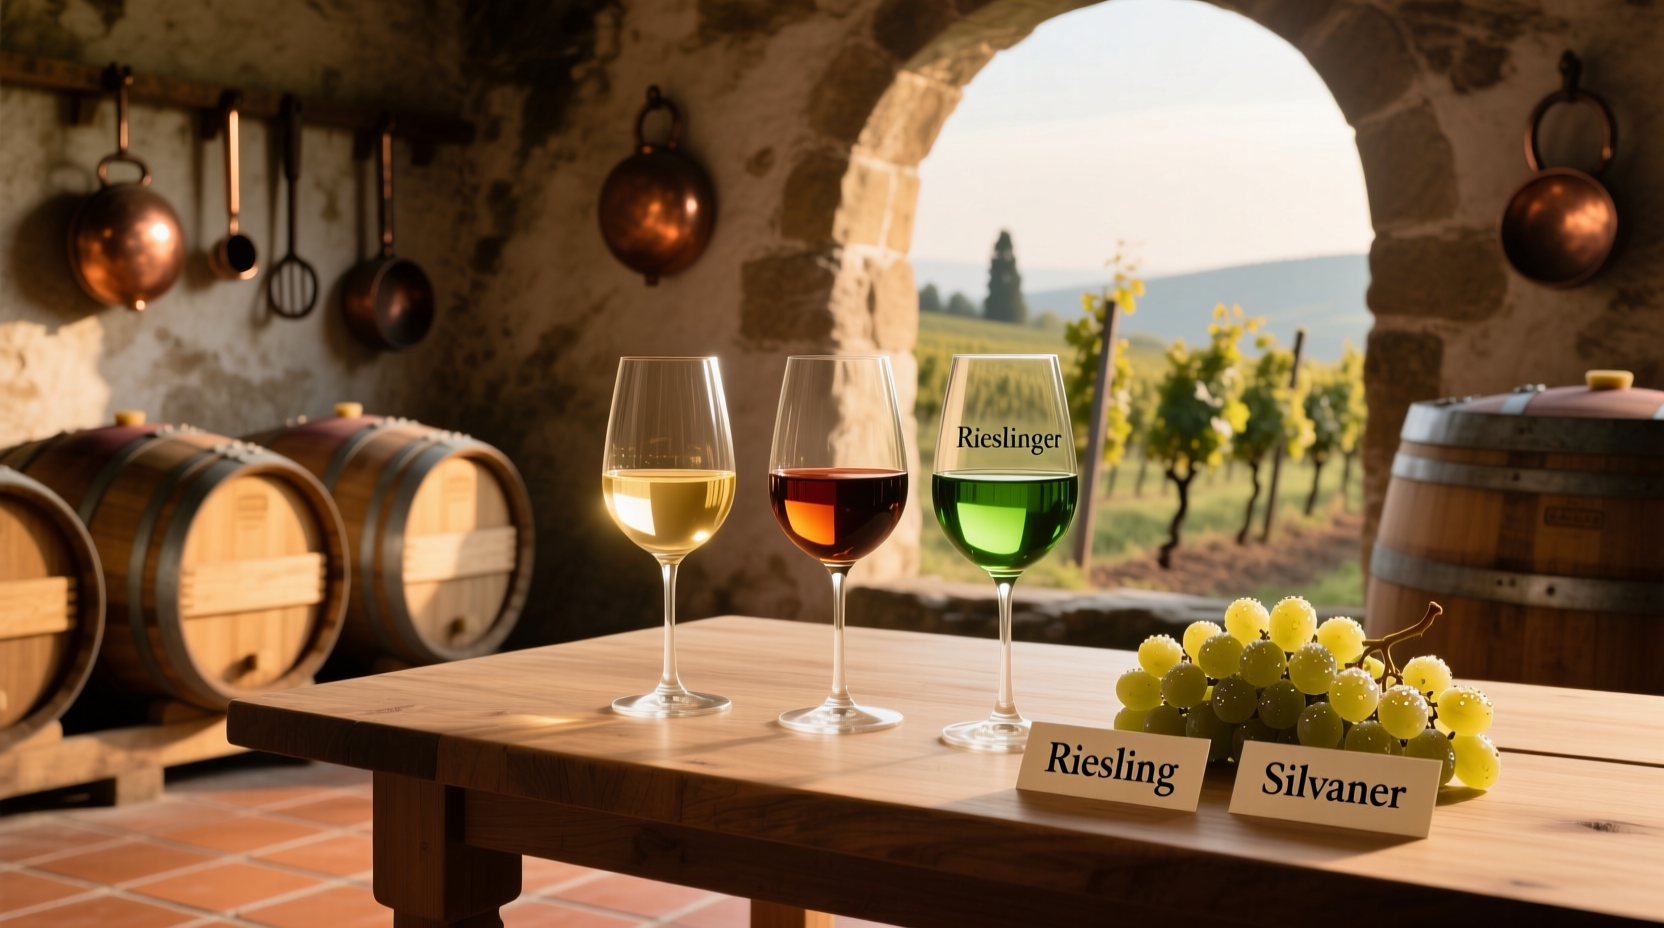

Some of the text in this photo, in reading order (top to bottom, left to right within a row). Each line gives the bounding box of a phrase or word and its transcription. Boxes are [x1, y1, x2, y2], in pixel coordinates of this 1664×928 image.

[957, 426, 1062, 456] Rieslinger
[1044, 741, 1180, 798] Riesling
[1261, 761, 1408, 809] Silvaner
